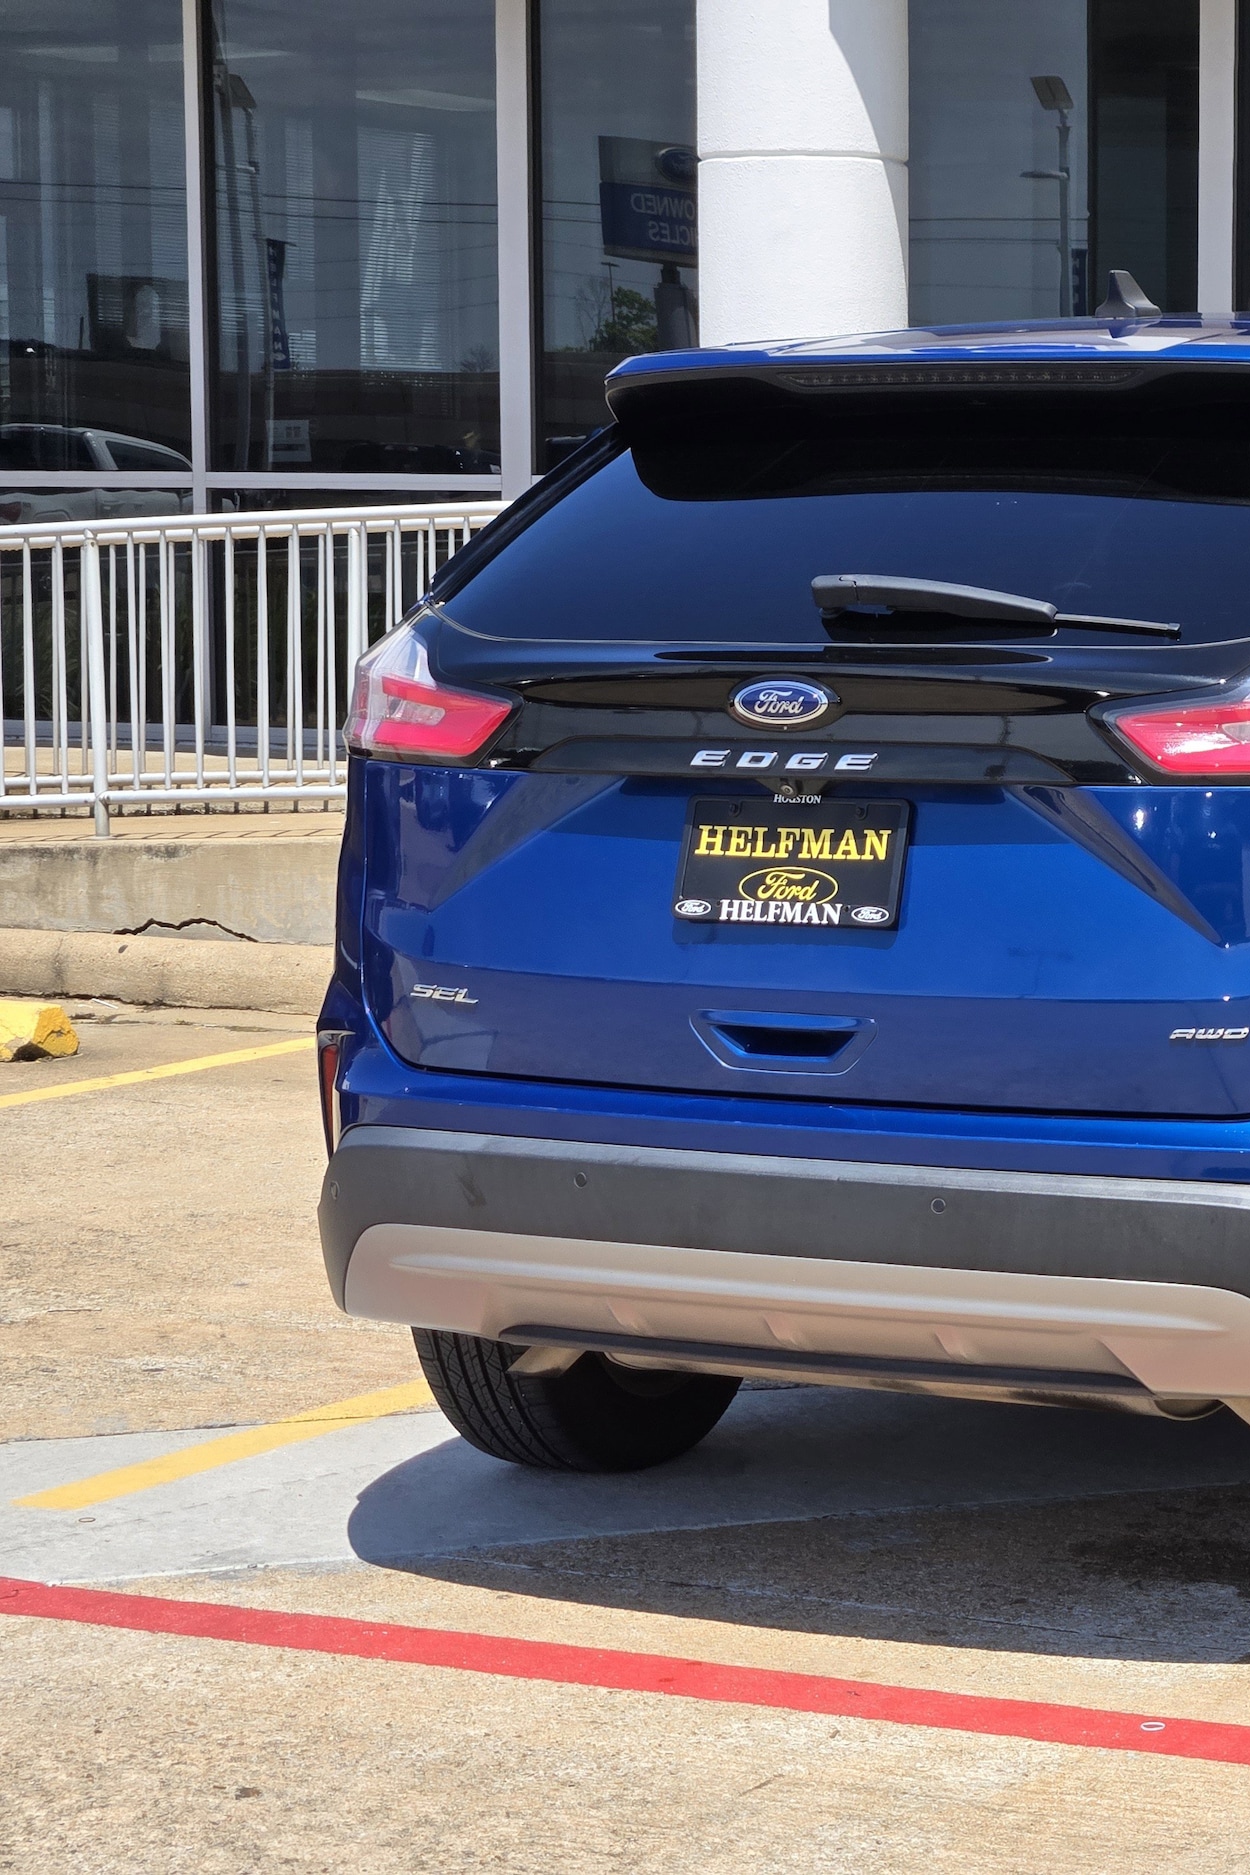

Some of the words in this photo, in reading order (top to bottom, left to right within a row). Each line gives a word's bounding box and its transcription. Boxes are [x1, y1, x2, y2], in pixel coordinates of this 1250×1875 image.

[754, 690, 805, 714] Ford
[689, 749, 879, 771] EDGE
[694, 824, 892, 860] HELFMAN
[757, 870, 820, 901] Ford
[719, 899, 843, 925] HELFMAN
[410, 983, 479, 1004] SEL
[1169, 1027, 1249, 1039] AWD
